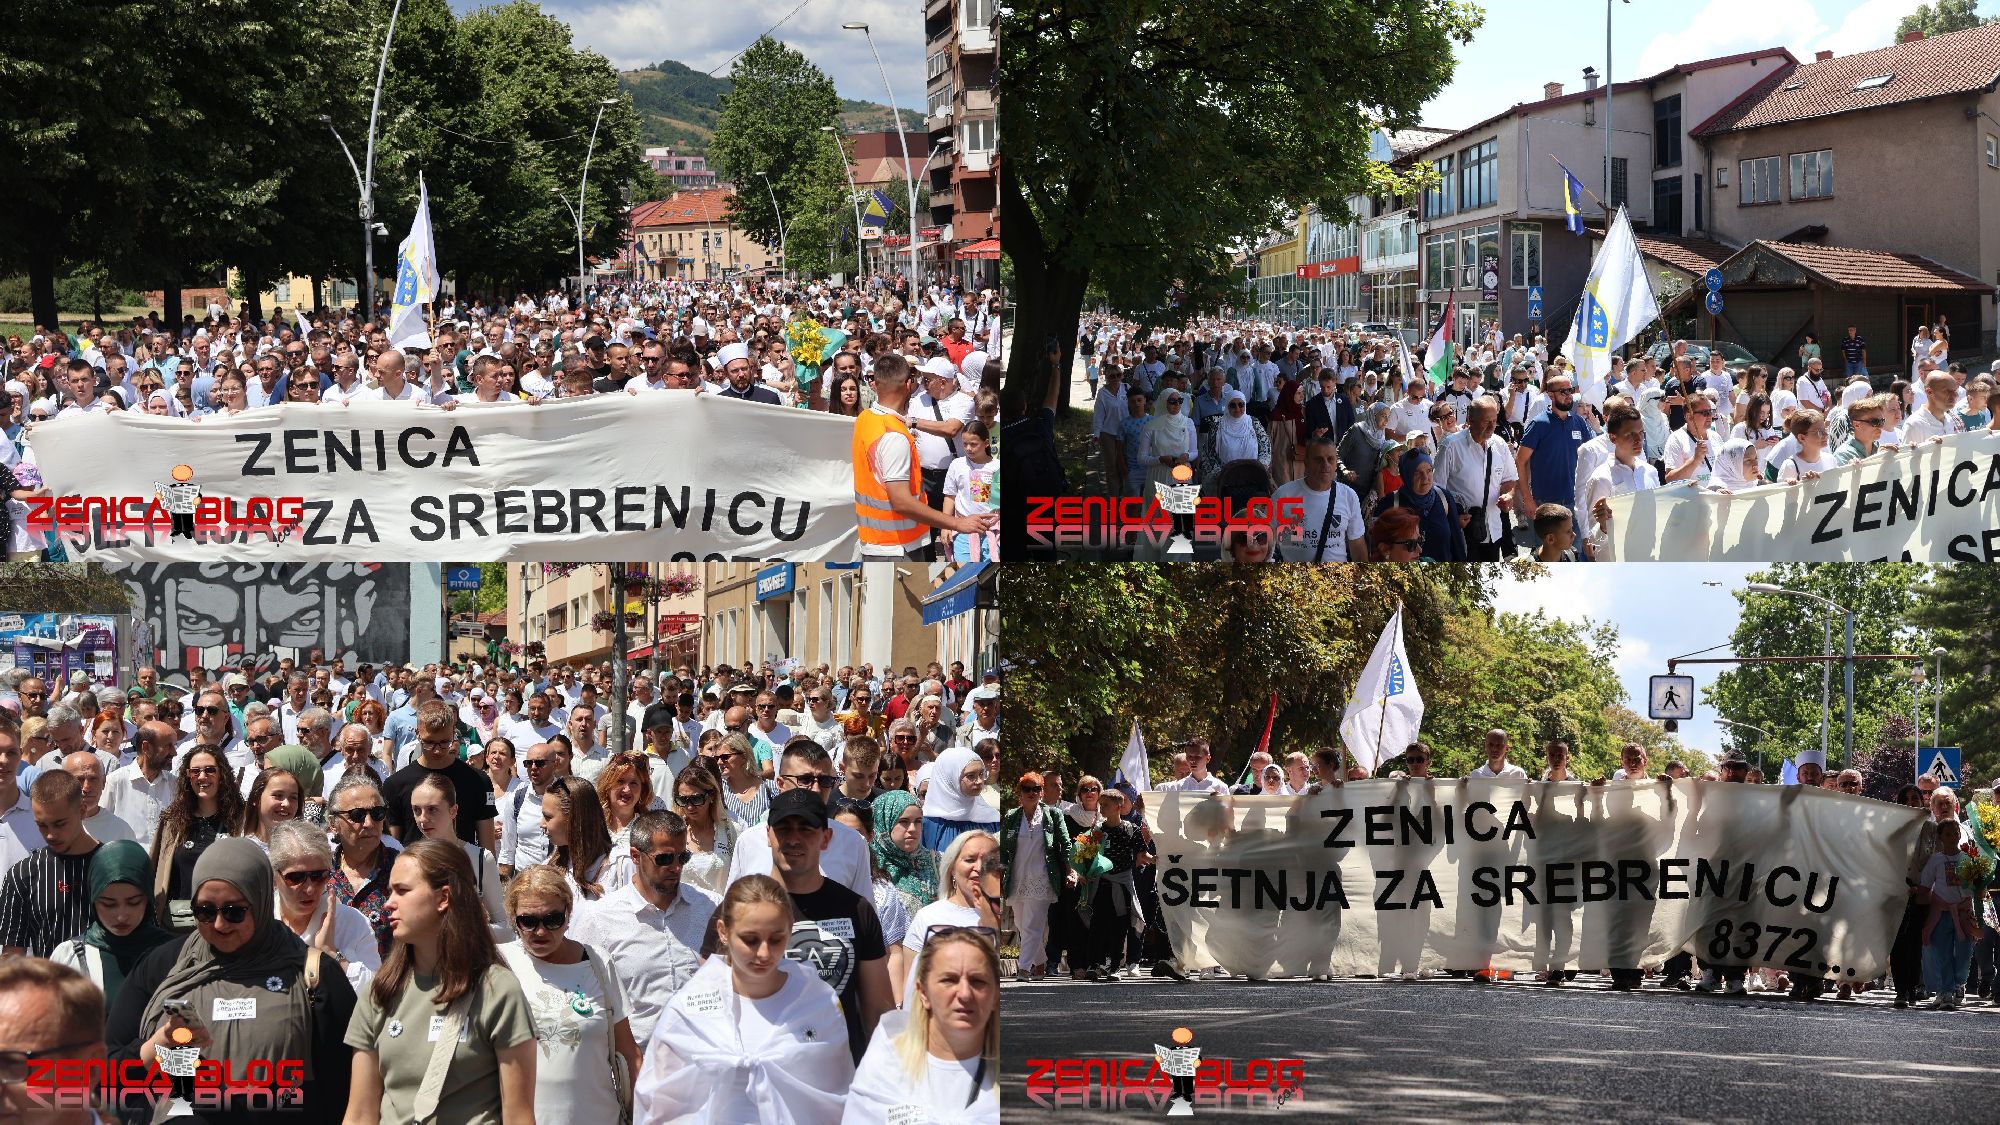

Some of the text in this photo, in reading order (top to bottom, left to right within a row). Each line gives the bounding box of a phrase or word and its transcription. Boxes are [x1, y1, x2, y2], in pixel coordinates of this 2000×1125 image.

[235, 425, 480, 476] ZENICA
[301, 498, 381, 546] ZA
[409, 485, 811, 542] SREBRENICU
[1811, 454, 2000, 544] ZENICA
[449, 580, 479, 588] FITING
[1320, 801, 1536, 848] ZENICA
[1161, 854, 1840, 913] ŠETNJA ZA SREBRENICU
[1708, 918, 1857, 977] 8372...
